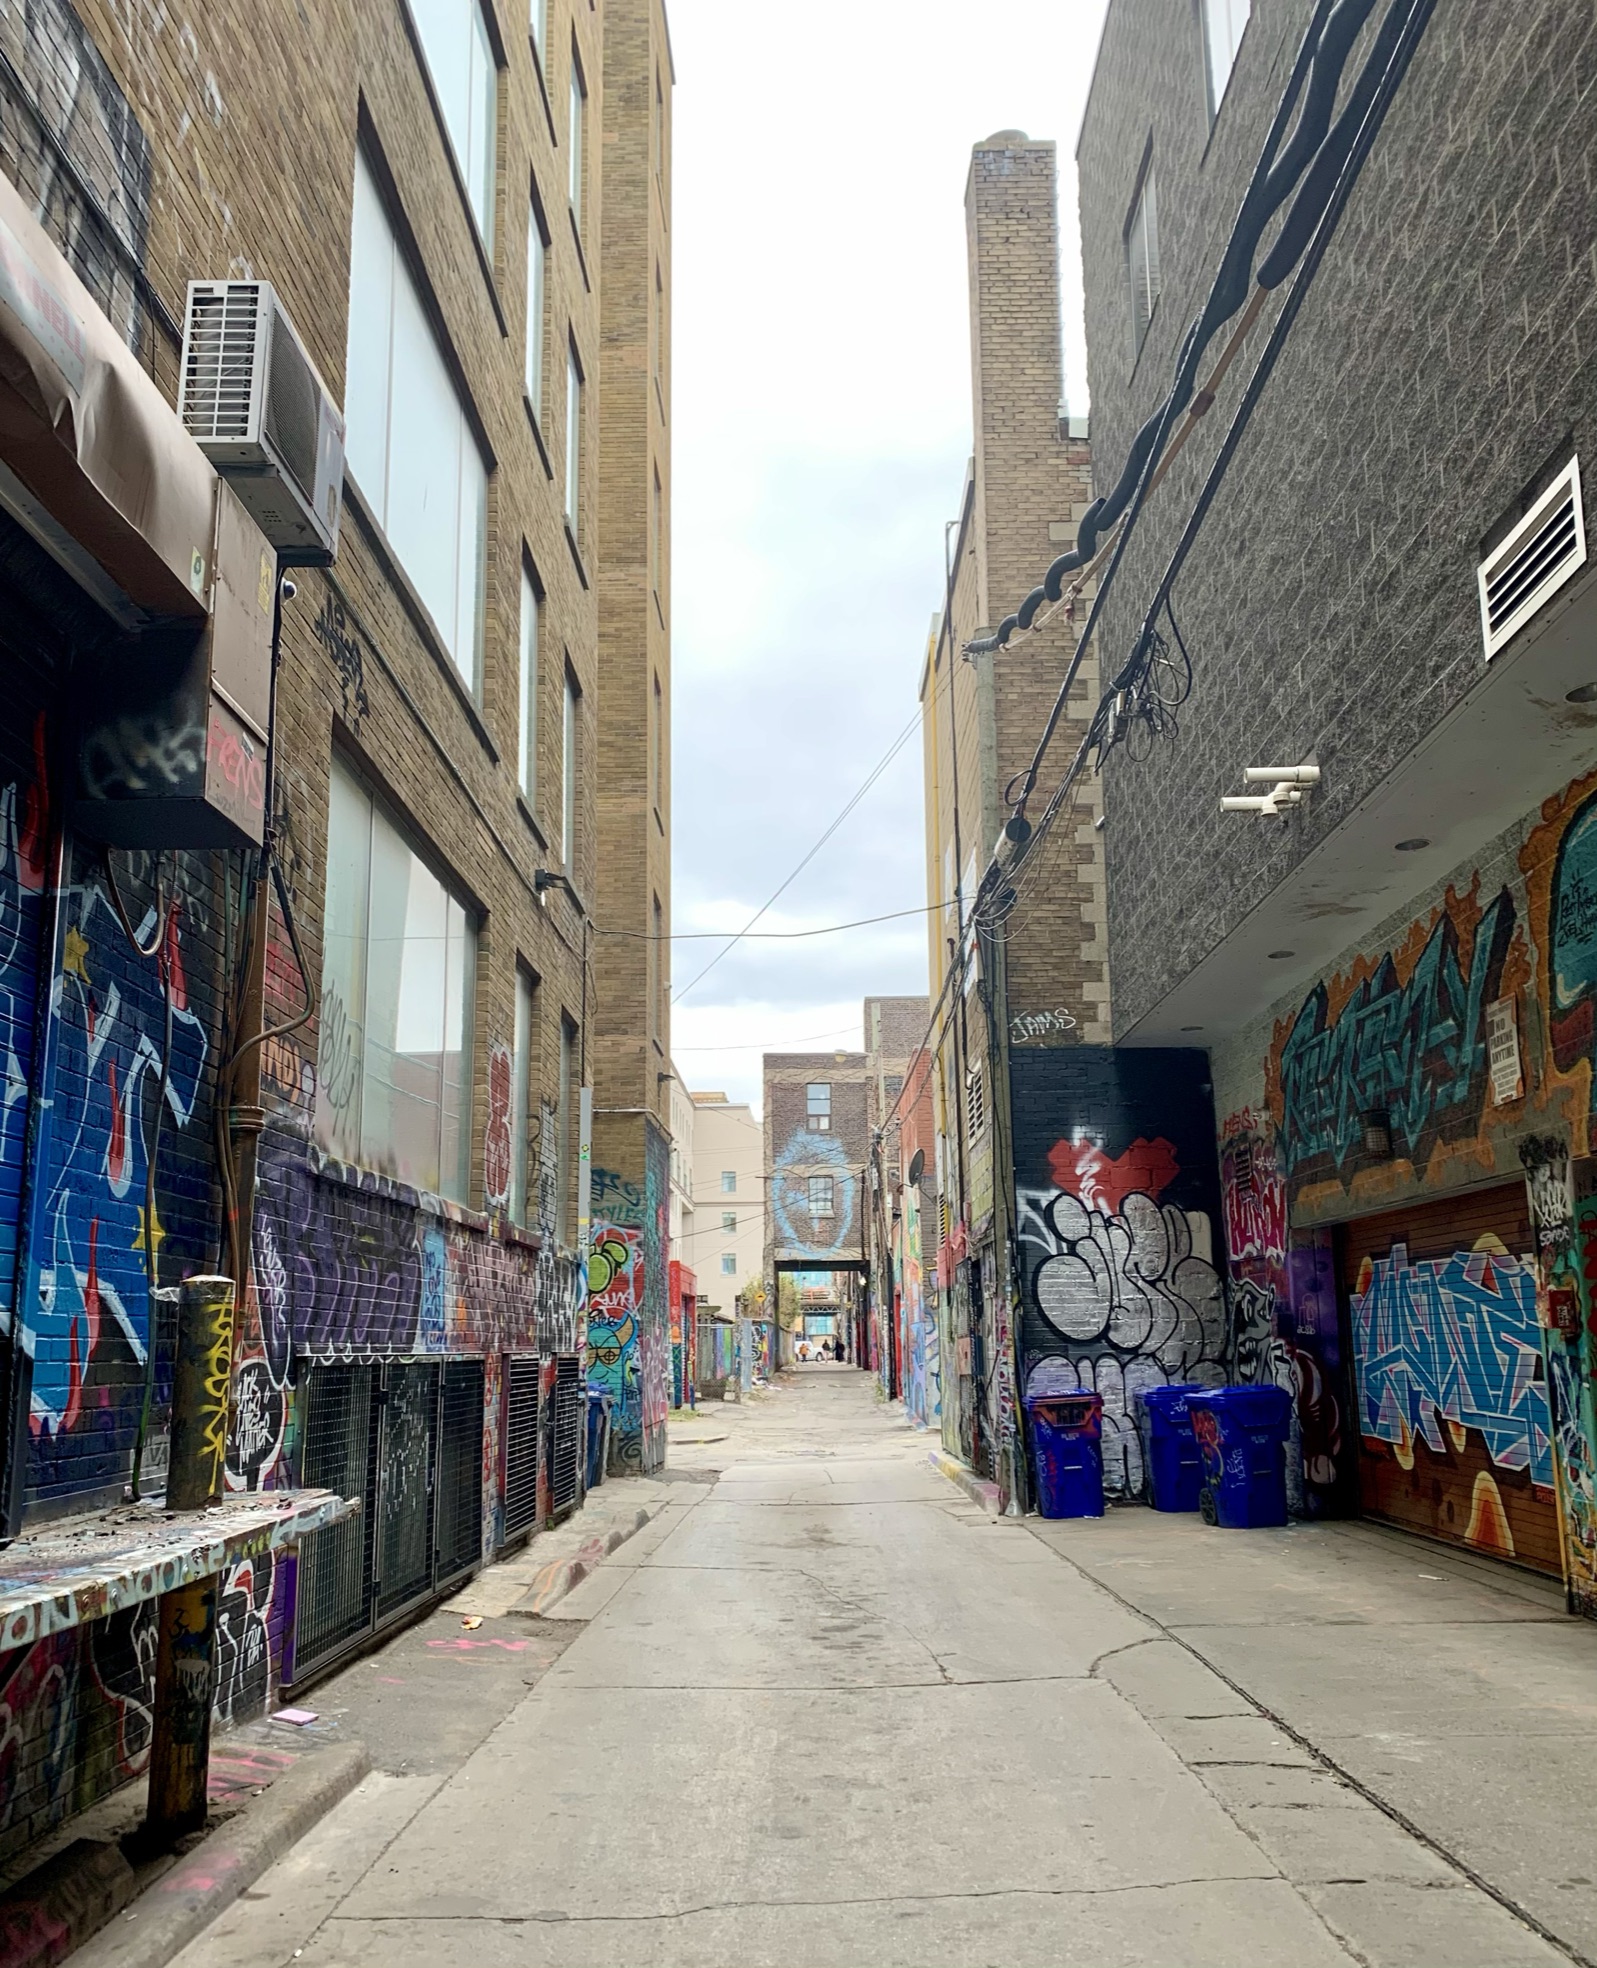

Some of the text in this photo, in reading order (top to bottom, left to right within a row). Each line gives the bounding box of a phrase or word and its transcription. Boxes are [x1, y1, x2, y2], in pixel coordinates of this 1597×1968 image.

[1008, 1007, 1076, 1043] JAMS
[1495, 1018, 1505, 1031] NO
[1490, 1028, 1513, 1051] PARKING
[1491, 1044, 1515, 1064] ANYTIME
